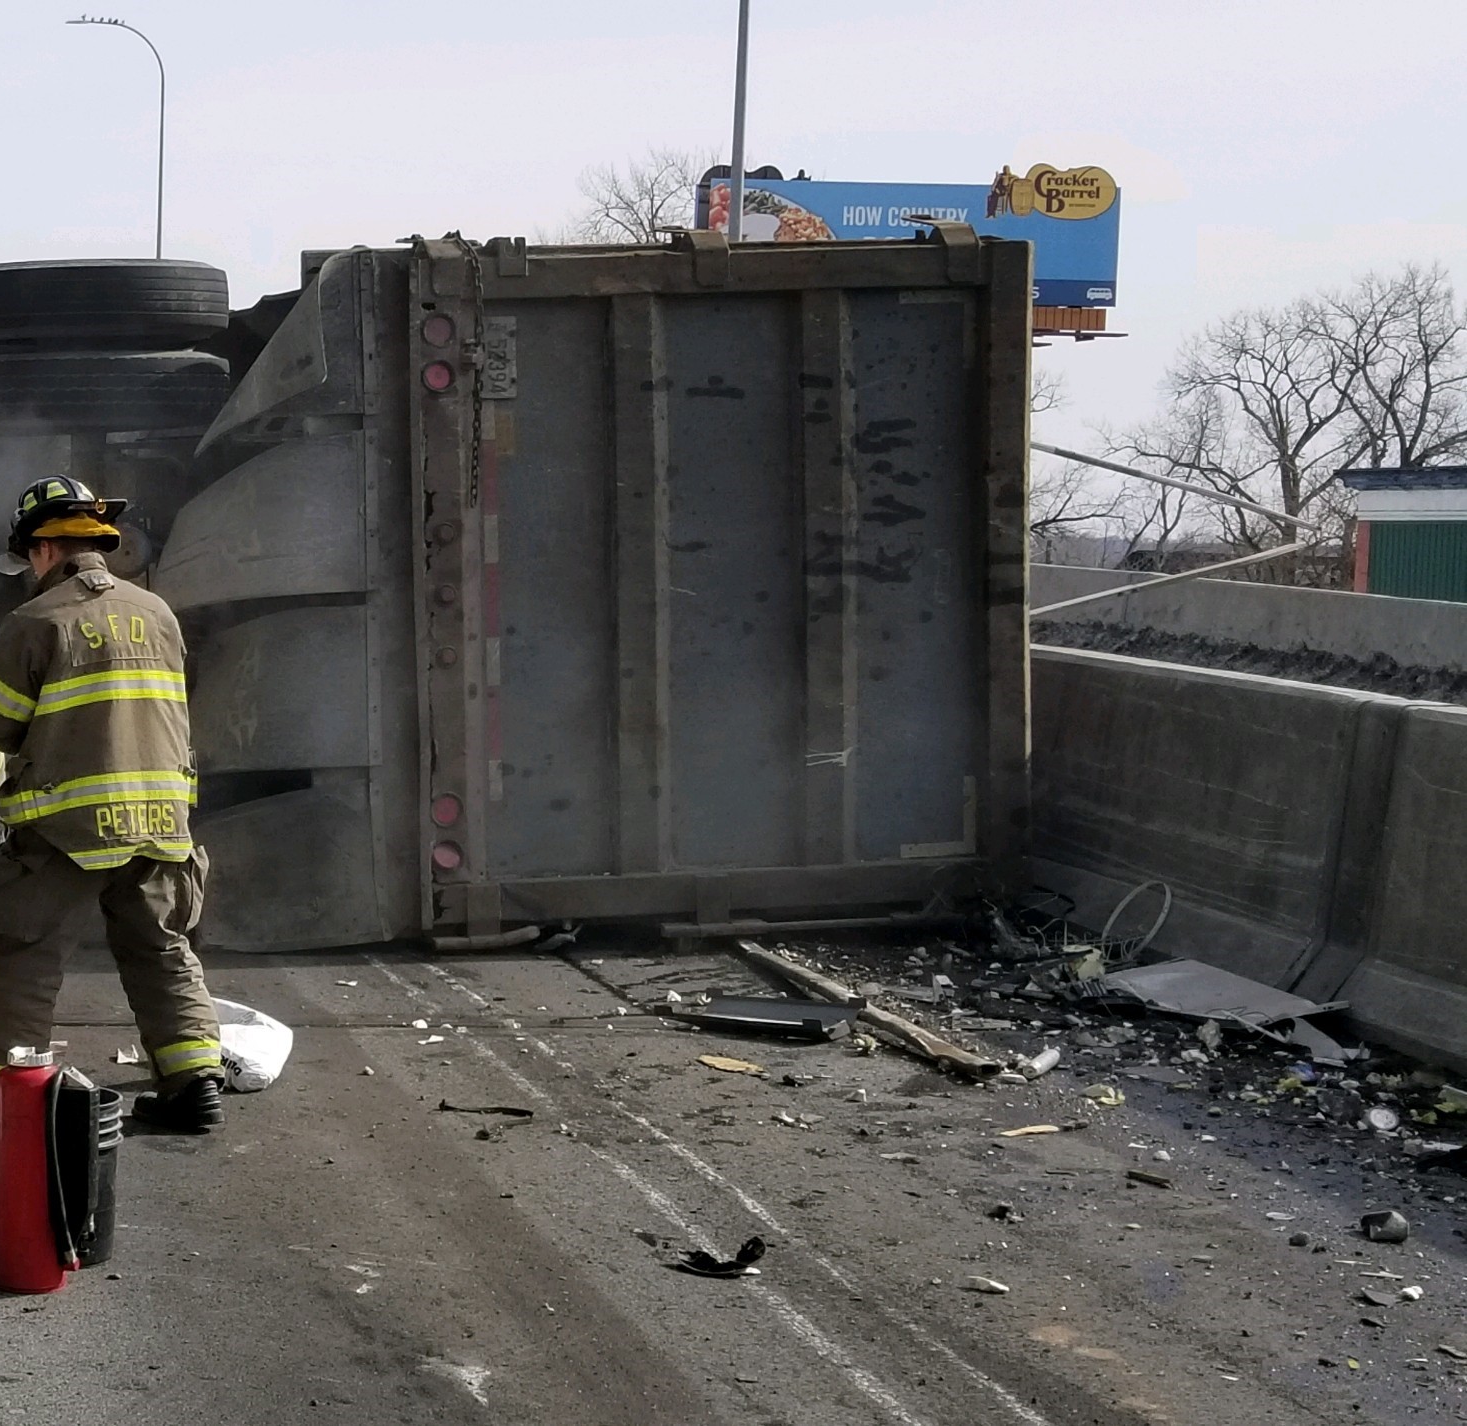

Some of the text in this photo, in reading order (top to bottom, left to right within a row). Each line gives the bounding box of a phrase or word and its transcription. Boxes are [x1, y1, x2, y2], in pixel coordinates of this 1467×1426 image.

[1034, 170, 1099, 198] Cracker
[1045, 187, 1100, 213] Barrel
[843, 206, 883, 226] HOW
[95, 801, 175, 837] PETERS
